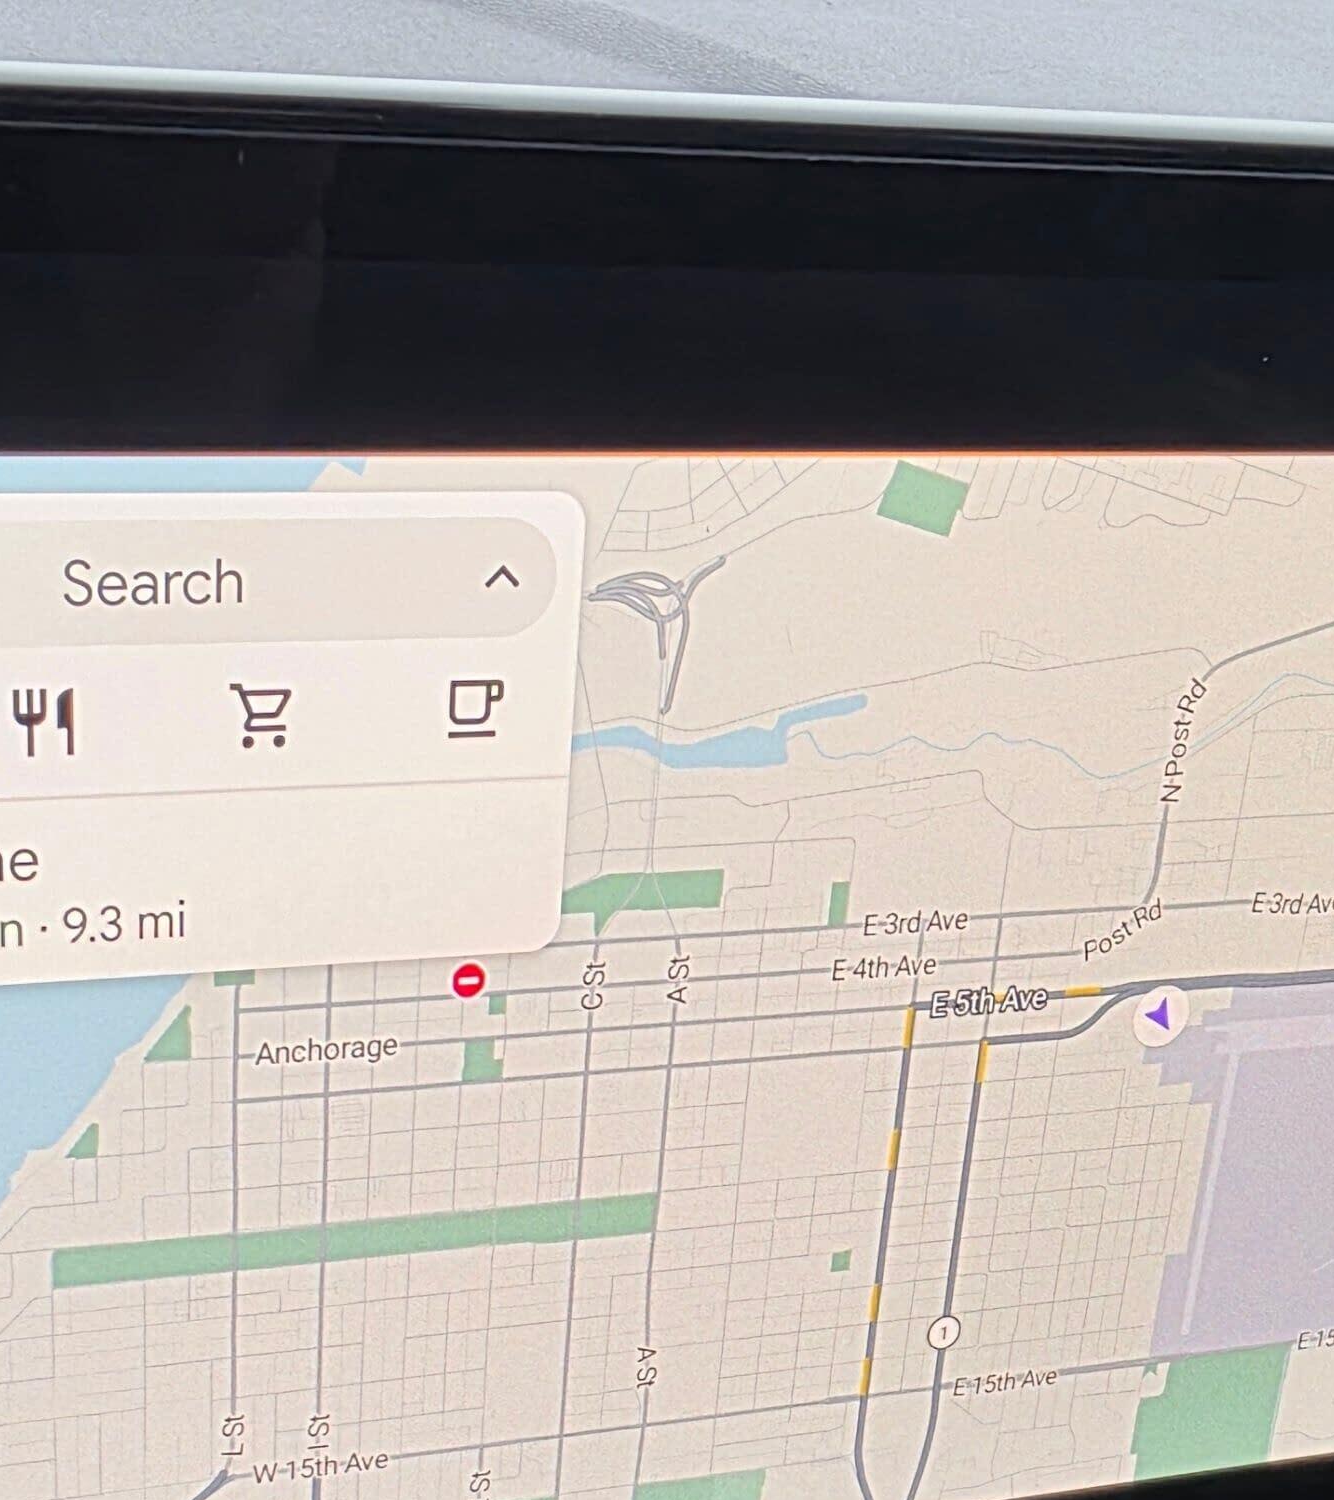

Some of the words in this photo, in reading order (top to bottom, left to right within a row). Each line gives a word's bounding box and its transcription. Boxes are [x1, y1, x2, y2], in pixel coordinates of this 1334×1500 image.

[64, 558, 244, 606] Search
[1176, 679, 1208, 716] Rd
[1165, 720, 1193, 778] Post
[1161, 786, 1181, 803] N
[1252, 892, 1266, 913] E
[1269, 893, 1304, 914] 3rd
[64, 908, 123, 944] 9.3
[138, 901, 186, 941] mi
[864, 915, 877, 936] E
[885, 911, 922, 935] 3rd
[925, 912, 968, 932] Ave
[1084, 920, 1133, 961] Post
[1133, 897, 1163, 930] Rd
[583, 962, 606, 985] St
[668, 956, 690, 980] St
[832, 960, 846, 980] E
[853, 956, 889, 979] 4th
[893, 955, 936, 976] Ave
[581, 993, 603, 1010] C
[667, 986, 687, 1004] A
[929, 992, 951, 1018] E
[955, 986, 997, 1014] 5th
[999, 985, 1048, 1012] Ave
[256, 1037, 398, 1065] Anchorage
[1298, 1331, 1310, 1350] E
[638, 1346, 657, 1363] A
[637, 1367, 658, 1389] St
[953, 1377, 967, 1397] E
[973, 1372, 1015, 1394] 15th
[1020, 1369, 1057, 1388] Ave
[222, 1414, 245, 1437] St
[308, 1414, 330, 1437] St
[221, 1442, 243, 1456] L
[254, 1463, 279, 1484] W
[285, 1455, 337, 1480] 15th
[344, 1453, 389, 1475] Ave
[469, 1470, 491, 1492] St
